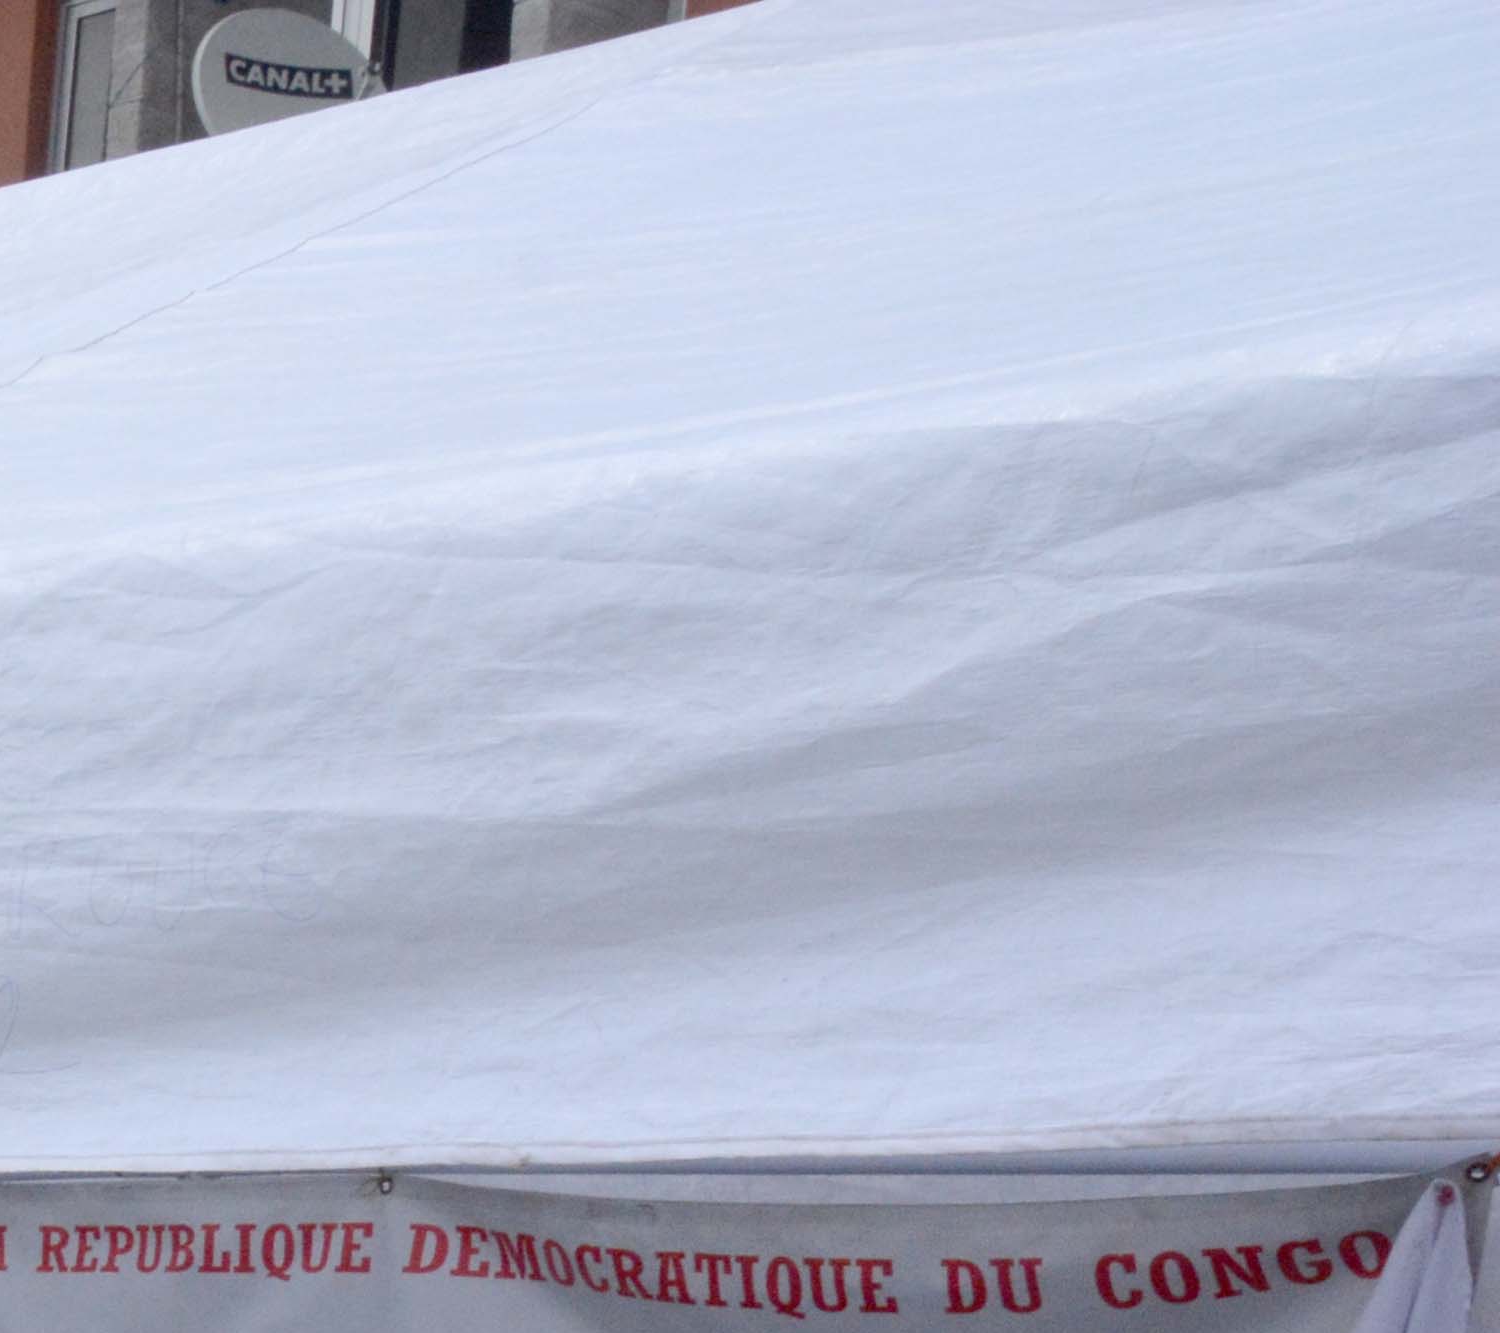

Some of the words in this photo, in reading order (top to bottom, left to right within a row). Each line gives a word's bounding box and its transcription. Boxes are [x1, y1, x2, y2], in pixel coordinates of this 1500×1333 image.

[229, 59, 350, 95] CANAL+
[37, 1223, 374, 1280] REPUBLIQUE
[403, 1224, 898, 1319] DEMOCRATIQUE
[942, 1257, 1043, 1315] DU
[1095, 1228, 1394, 1310] CONGO
